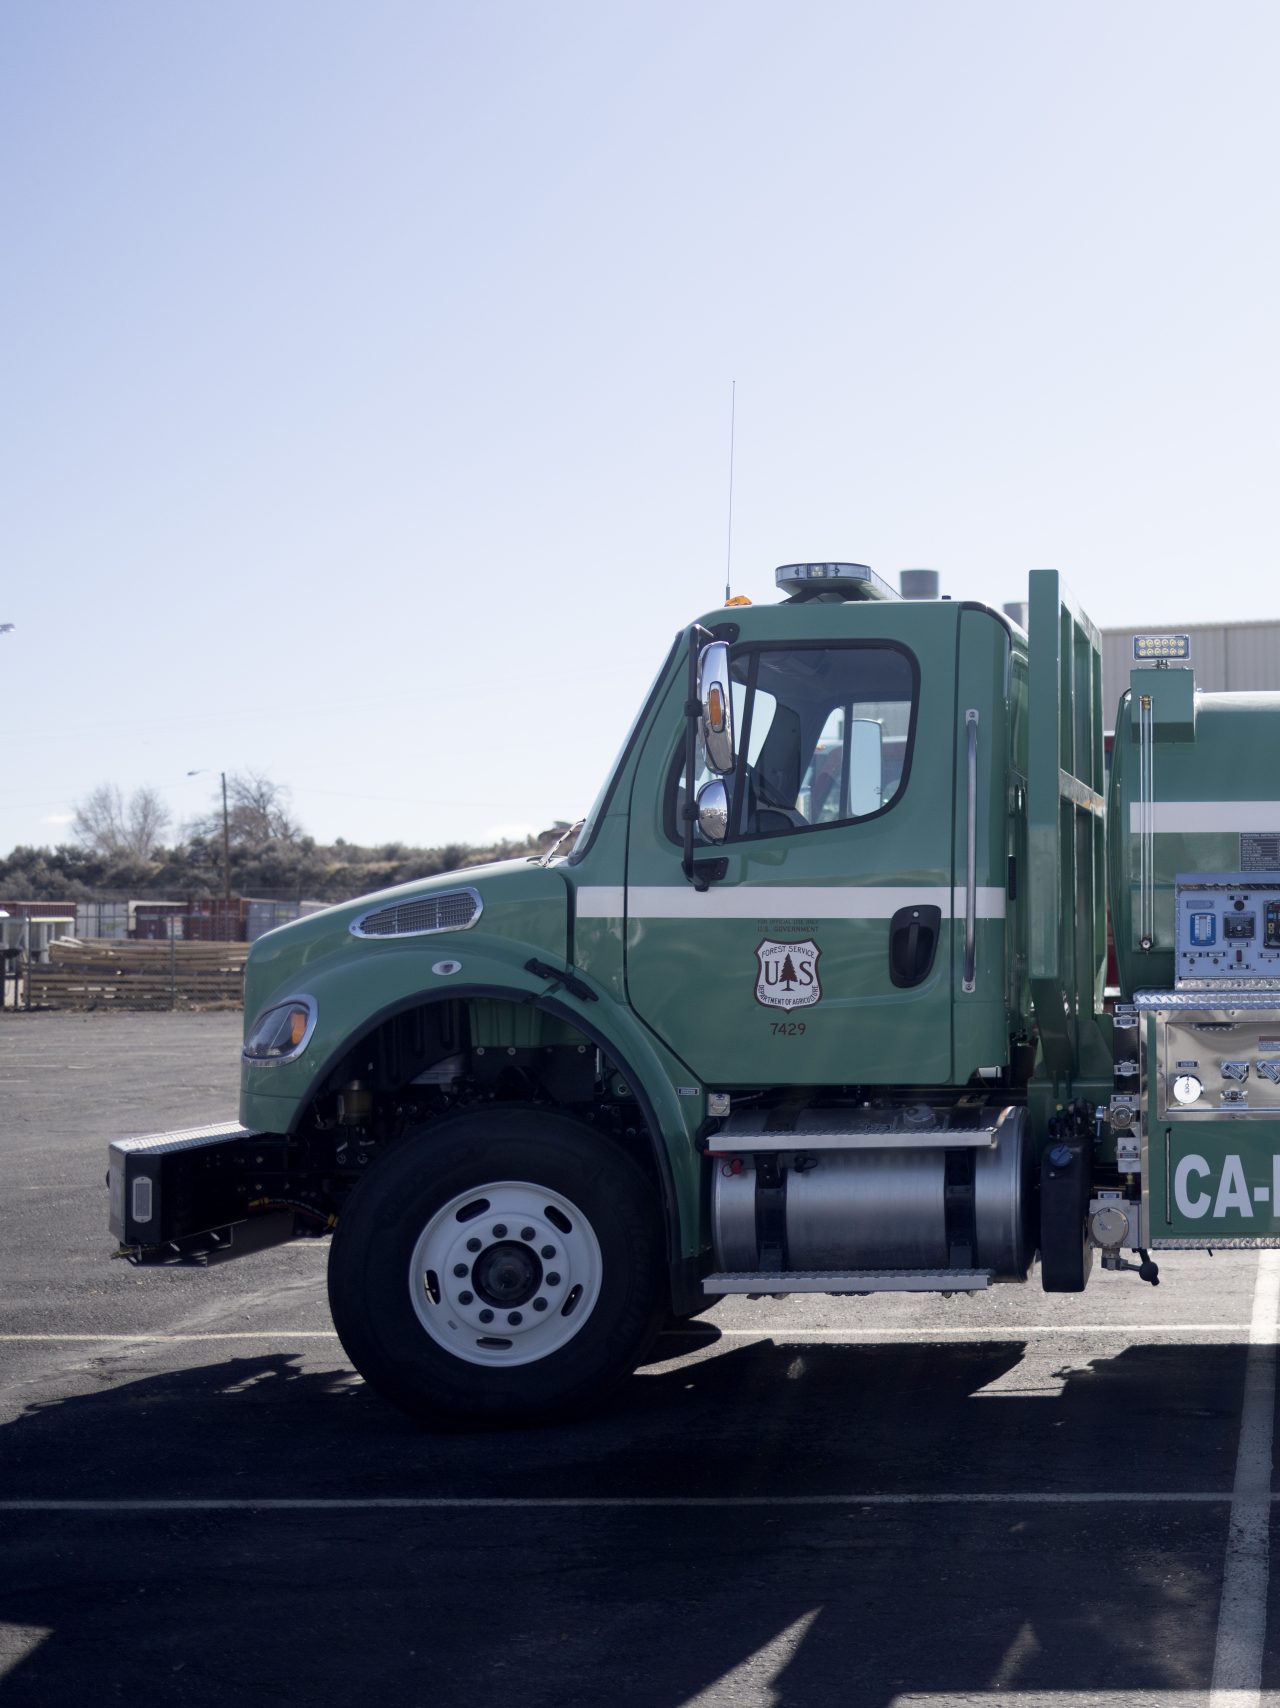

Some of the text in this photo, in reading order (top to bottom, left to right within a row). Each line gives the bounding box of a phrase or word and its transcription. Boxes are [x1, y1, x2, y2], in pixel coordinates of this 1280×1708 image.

[761, 945, 815, 959] FOREST SERVICE
[759, 984, 819, 1006] DEPARTMENT OF AGRICULTURE
[769, 1022, 806, 1036] 7429
